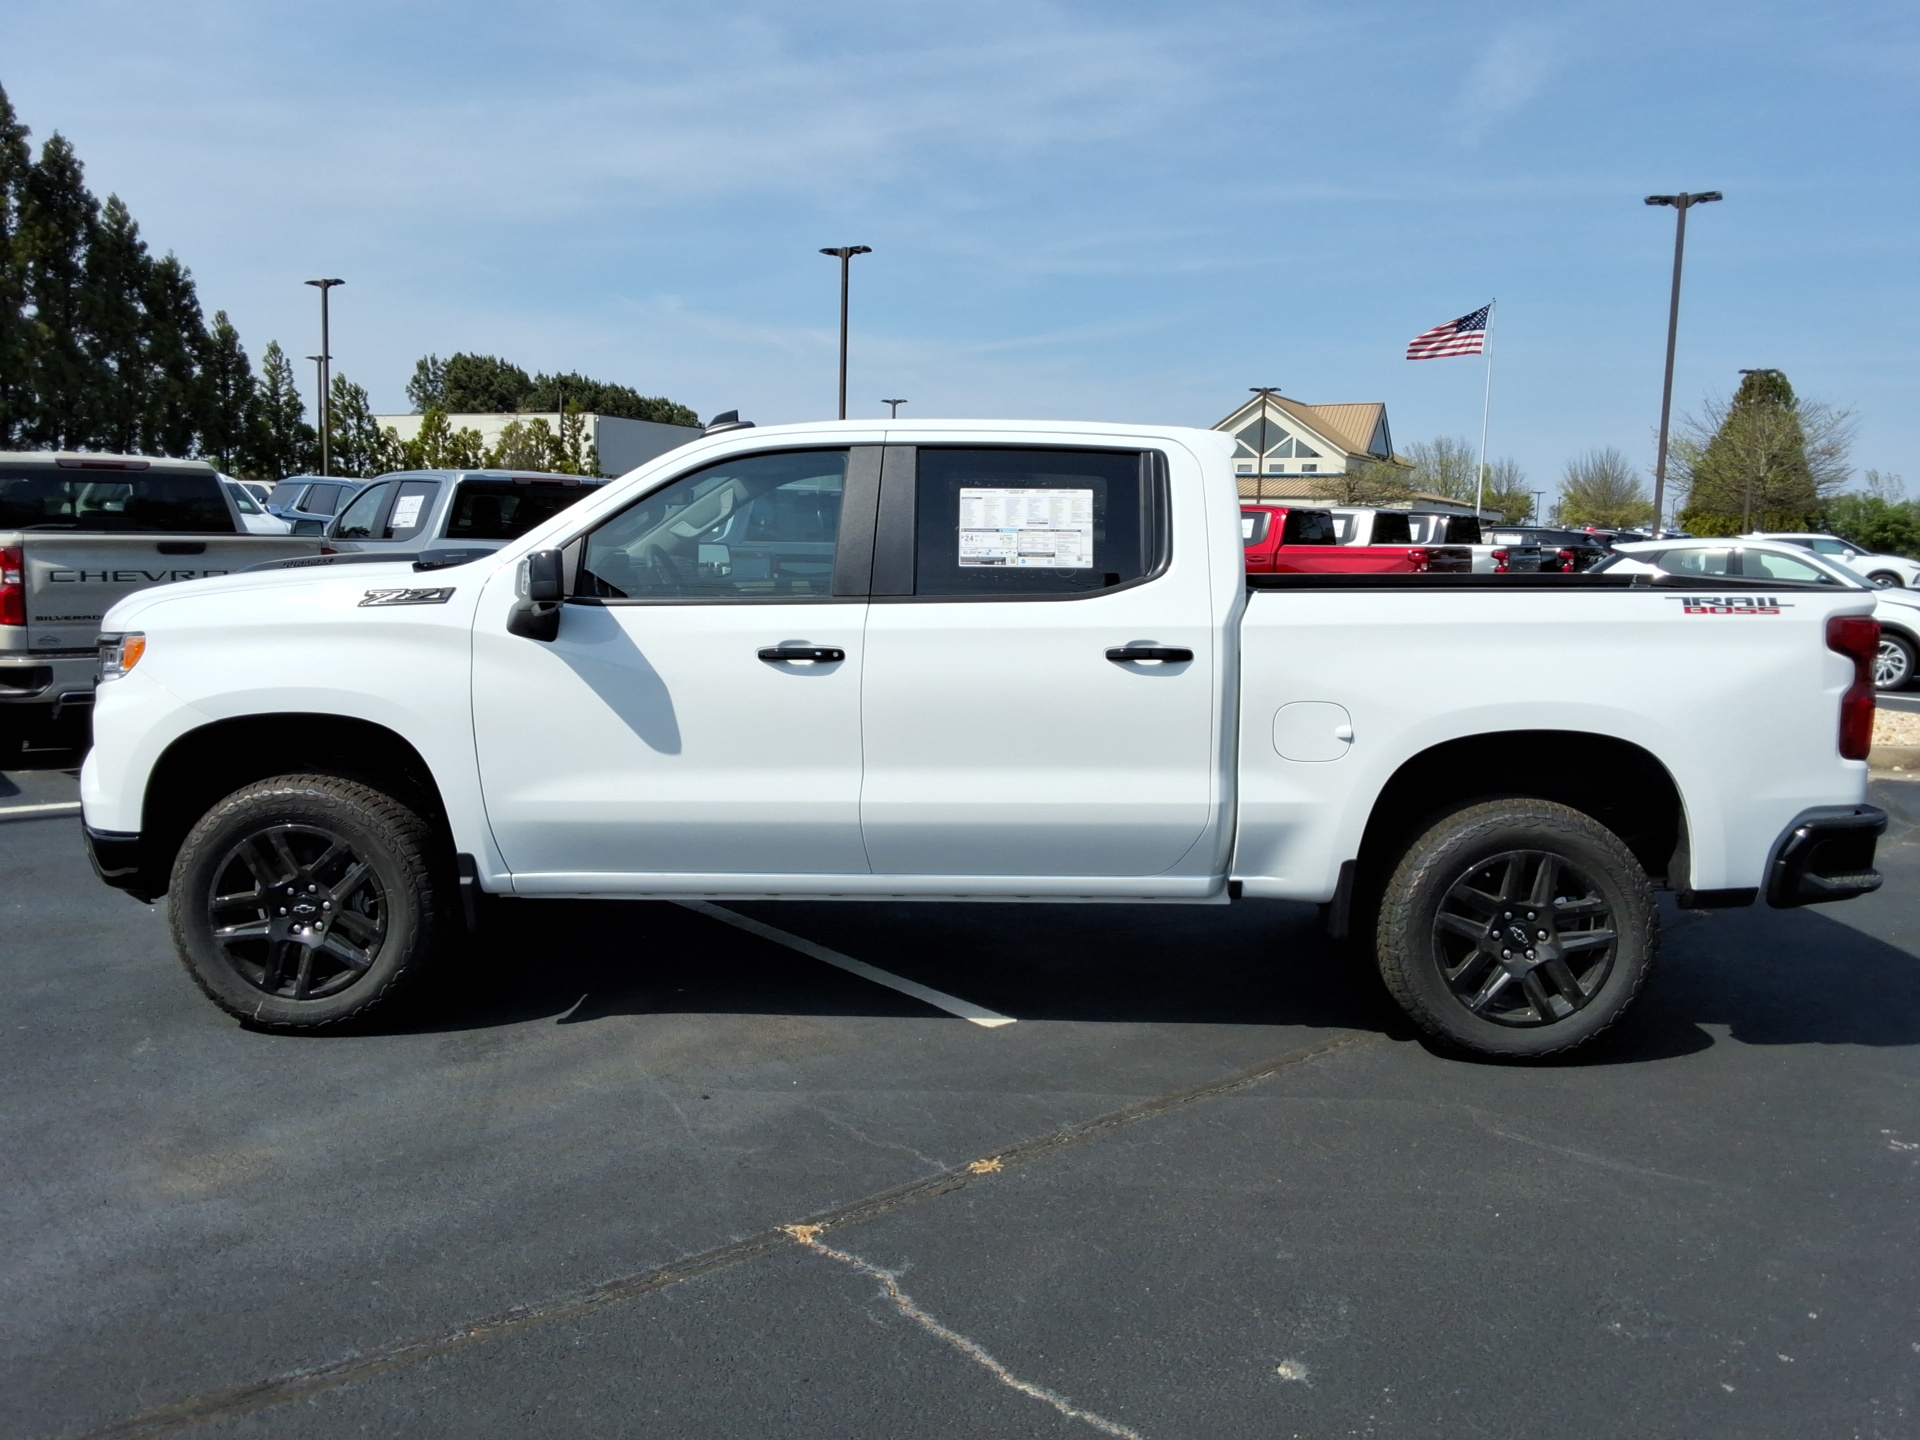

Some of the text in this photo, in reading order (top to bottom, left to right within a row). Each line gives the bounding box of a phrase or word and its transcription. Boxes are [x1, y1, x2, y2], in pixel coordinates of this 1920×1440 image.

[357, 587, 457, 607] Z71
[1665, 597, 1795, 607] TRAIL
[1684, 607, 1781, 615] BOSS
